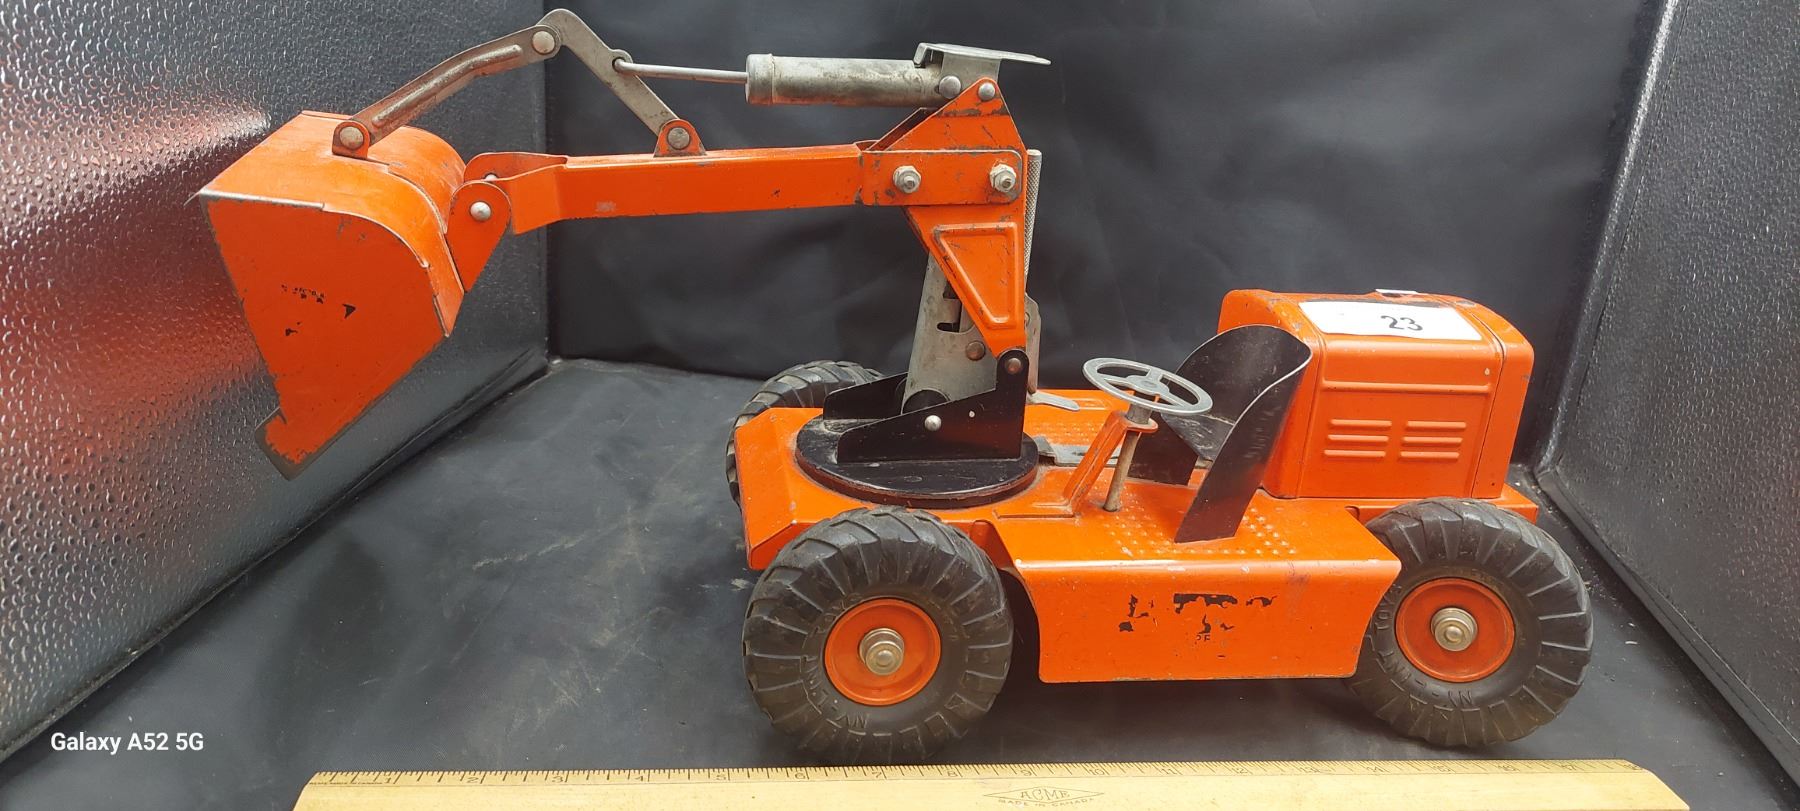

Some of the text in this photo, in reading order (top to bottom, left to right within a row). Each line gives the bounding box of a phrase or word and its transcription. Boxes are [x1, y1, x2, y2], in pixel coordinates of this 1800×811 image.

[1380, 314, 1423, 331] 23
[466, 776, 479, 784] 2
[551, 775, 564, 783] 3
[794, 770, 806, 780] 6
[871, 770, 882, 779] 7
[947, 769, 959, 778] 8
[1020, 768, 1033, 777] 9
[1088, 767, 1106, 776] 10
[1020, 787, 1071, 801] ACME
[998, 798, 1029, 807] MADE
